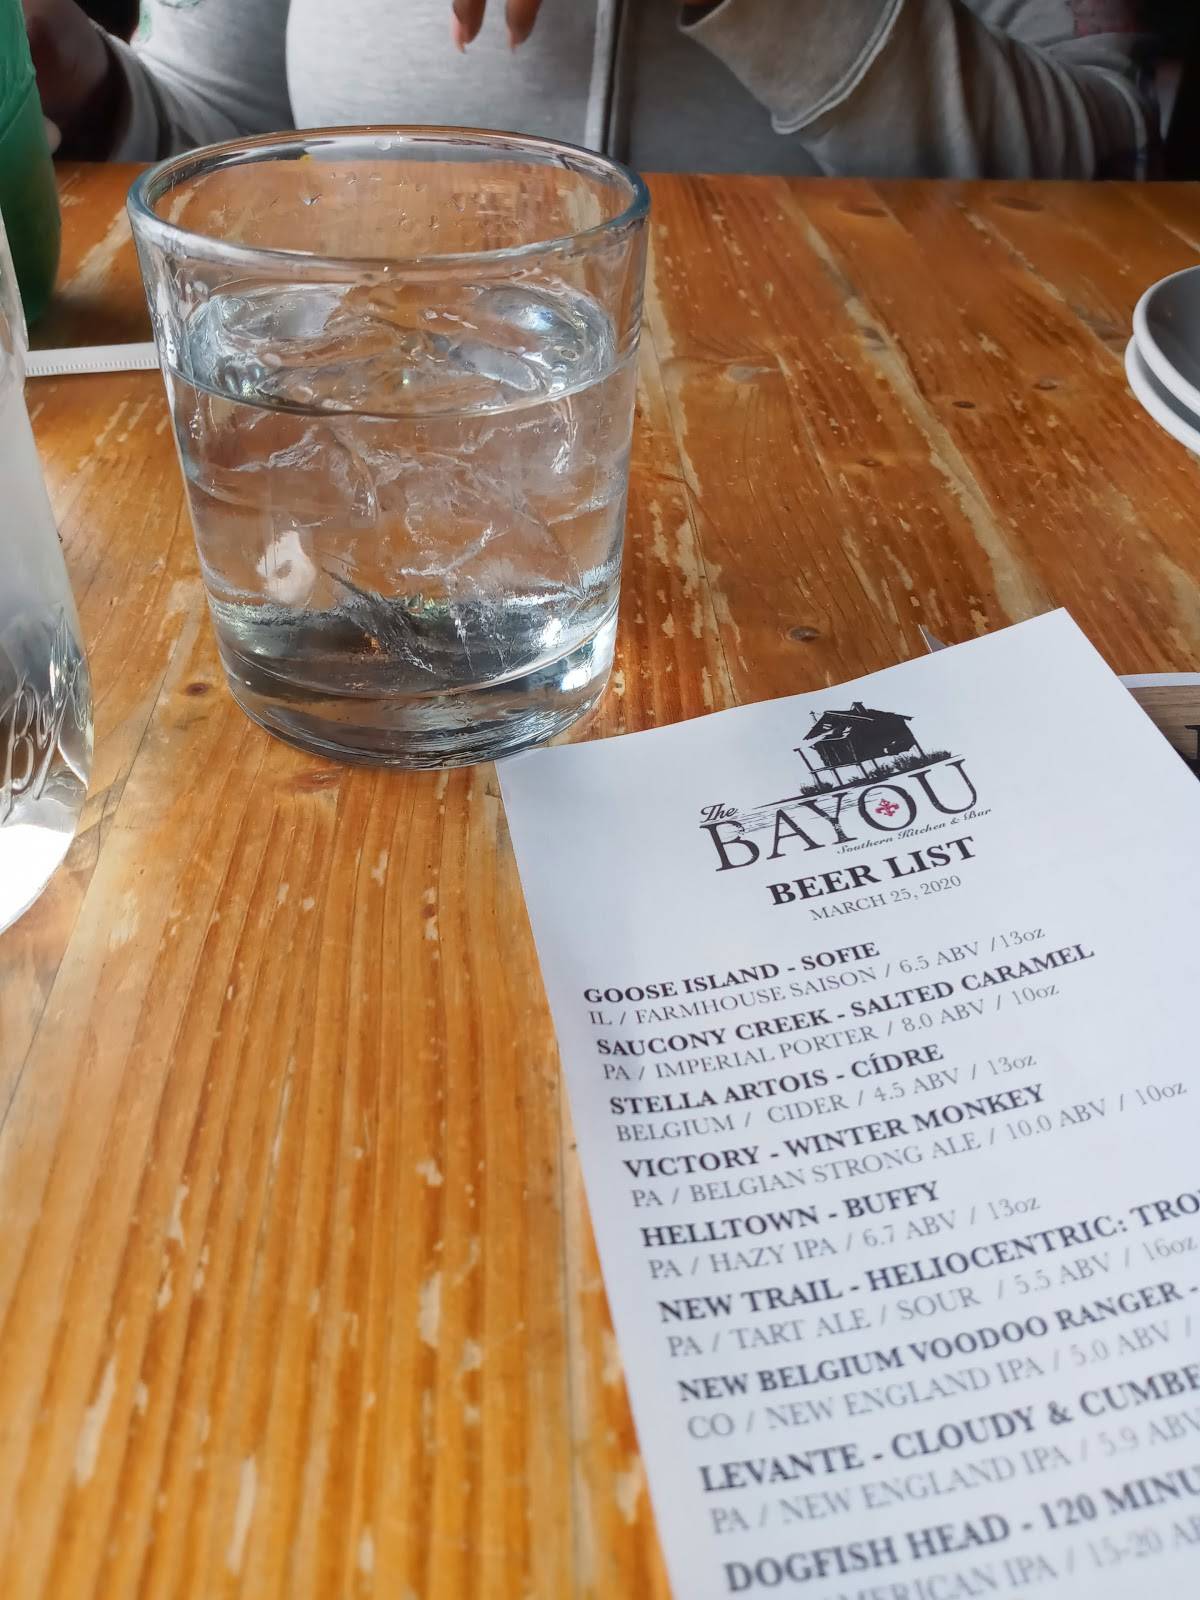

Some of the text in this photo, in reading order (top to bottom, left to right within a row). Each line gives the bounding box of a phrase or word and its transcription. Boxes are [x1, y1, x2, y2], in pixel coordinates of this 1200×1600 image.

[700, 803, 739, 822] The
[700, 759, 977, 872] BAYOU
[837, 808, 992, 855] Southern Kitchen & Bar
[766, 836, 976, 905] BEER LIST
[809, 874, 962, 920] MARCH 25, 2020
[583, 981, 679, 1003] GOOSE
[684, 963, 780, 994] ISLAND
[801, 942, 880, 971] SOFIE
[588, 1011, 612, 1025] IL
[635, 987, 786, 1024] FARMHOUSE
[790, 967, 877, 997] SAISON
[899, 956, 930, 974] 6.5
[936, 941, 981, 966] ABV
[596, 1028, 726, 1057] SAUCONY
[735, 1009, 832, 1040] CREEK
[850, 981, 955, 1018] SALTED
[961, 943, 1095, 991] CARAMEL
[602, 1064, 631, 1080] PA
[655, 1047, 776, 1079] IMPERIAL
[779, 1025, 879, 1058] PORTER
[901, 1012, 933, 1032] 8.0
[940, 998, 985, 1025] ABV
[1011, 983, 1060, 1006] 10oz
[609, 1089, 718, 1116] STELLA
[723, 1068, 829, 1102] ARTOIS
[851, 1044, 945, 1078] CÍDRE
[616, 1113, 735, 1142] BELGIUM
[766, 1093, 848, 1123] CIDER
[873, 1083, 905, 1103] 4.5
[913, 1067, 961, 1095] ABV
[987, 1053, 1037, 1076] 13oz
[623, 1145, 760, 1178] VICTORY
[783, 1118, 909, 1157] WINTER
[911, 1083, 1046, 1132] MONKEY
[631, 1188, 664, 1208] PA
[689, 1168, 806, 1202] BELGIAN
[811, 1145, 923, 1183] STRONG
[931, 1132, 982, 1159] ALE
[1006, 1114, 1052, 1140] 10.0
[1059, 1098, 1108, 1127] ABV
[1134, 1080, 1187, 1106] 10oz
[640, 1205, 820, 1247] HELLTOWN
[842, 1180, 939, 1219] BUFFY
[648, 1259, 682, 1280] PA
[709, 1244, 785, 1273] HAZY
[793, 1237, 838, 1260] IPA
[863, 1224, 895, 1248] 6.7
[905, 1209, 956, 1239] ABV
[987, 1196, 1040, 1221] 13oz
[658, 1294, 734, 1323] NEW
[740, 1278, 843, 1313] TRAIL
[865, 1215, 1128, 1292] HELIOCENTRIC:
[1128, 1189, 1200, 1228] TRO
[667, 1335, 703, 1358] PA
[729, 1319, 805, 1350] TART
[816, 1308, 871, 1338] ALE
[896, 1286, 981, 1320] SOUR
[1014, 1269, 1051, 1295] 5.5
[1060, 1253, 1110, 1284] ABV
[1142, 1235, 1198, 1261] 16oz
[677, 1373, 748, 1401] NEW
[756, 1346, 904, 1392] BELGIUM
[907, 1315, 1048, 1363] VOODOO
[1054, 1281, 1184, 1330] RANGER
[687, 1412, 735, 1439] CO
[765, 1397, 834, 1429] NEW
[844, 1366, 990, 1416] ENGLAND
[997, 1356, 1044, 1384] IPA
[1070, 1338, 1109, 1366] 5.0
[1117, 1319, 1169, 1356] ABV
[699, 1443, 865, 1492] LEVANTE
[891, 1405, 1035, 1459] CLOUDY
[1047, 1401, 1074, 1425] &
[1079, 1363, 1200, 1417] CUMBE
[710, 1507, 750, 1535] PA
[778, 1488, 851, 1524] NEW
[861, 1455, 1016, 1510] ENGLAND
[1021, 1445, 1072, 1475] IPA
[723, 1535, 899, 1592] DOGFISH
[905, 1513, 1010, 1560] HEAD
[1040, 1493, 1098, 1530] 120
[818, 1565, 998, 1600] RICAN
[1003, 1553, 1058, 1588] IPA
